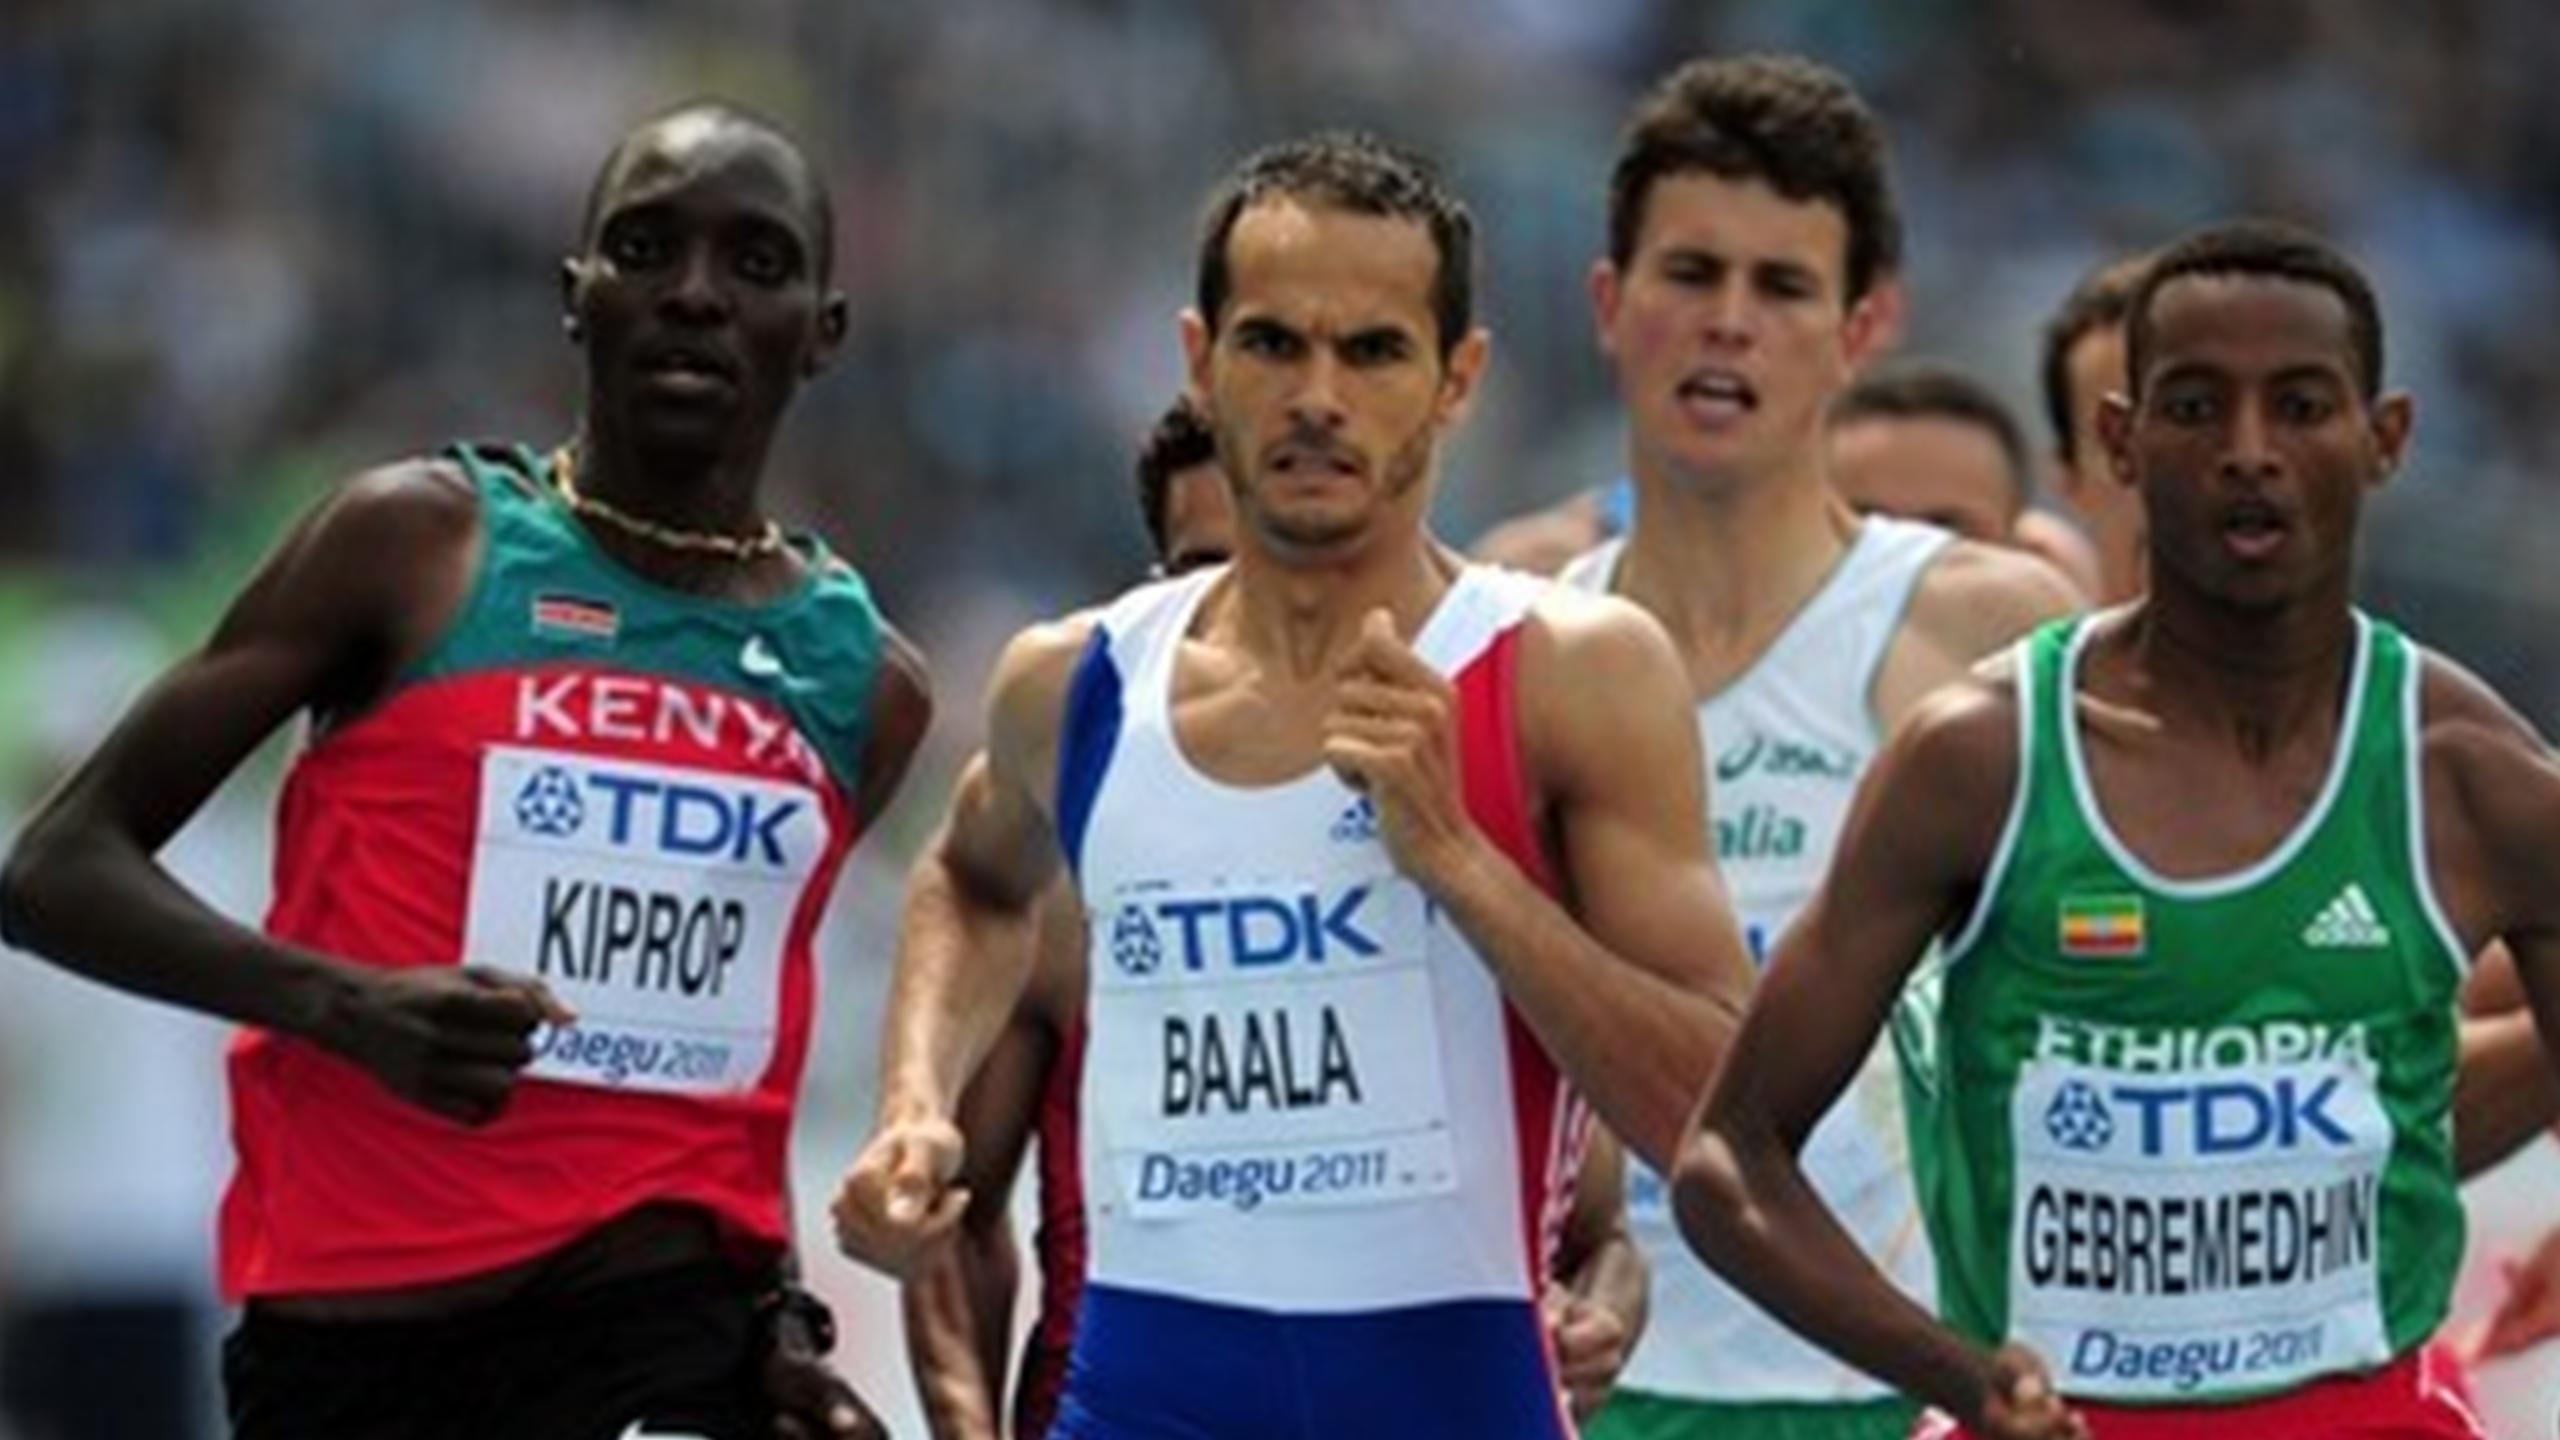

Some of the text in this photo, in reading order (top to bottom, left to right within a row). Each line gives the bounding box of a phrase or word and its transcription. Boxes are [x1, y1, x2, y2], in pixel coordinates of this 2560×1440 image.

[587, 774, 799, 866] TDK
[538, 878, 745, 999] KIPROP
[1157, 884, 1382, 971] TDK
[1162, 1004, 1361, 1118] BAALA
[2112, 1076, 2356, 1156] TDK
[1136, 1150, 1387, 1209] Daegu 2011
[2024, 1174, 2370, 1296] GEBREMEDHIN
[2069, 1328, 2237, 1390] Daegu
